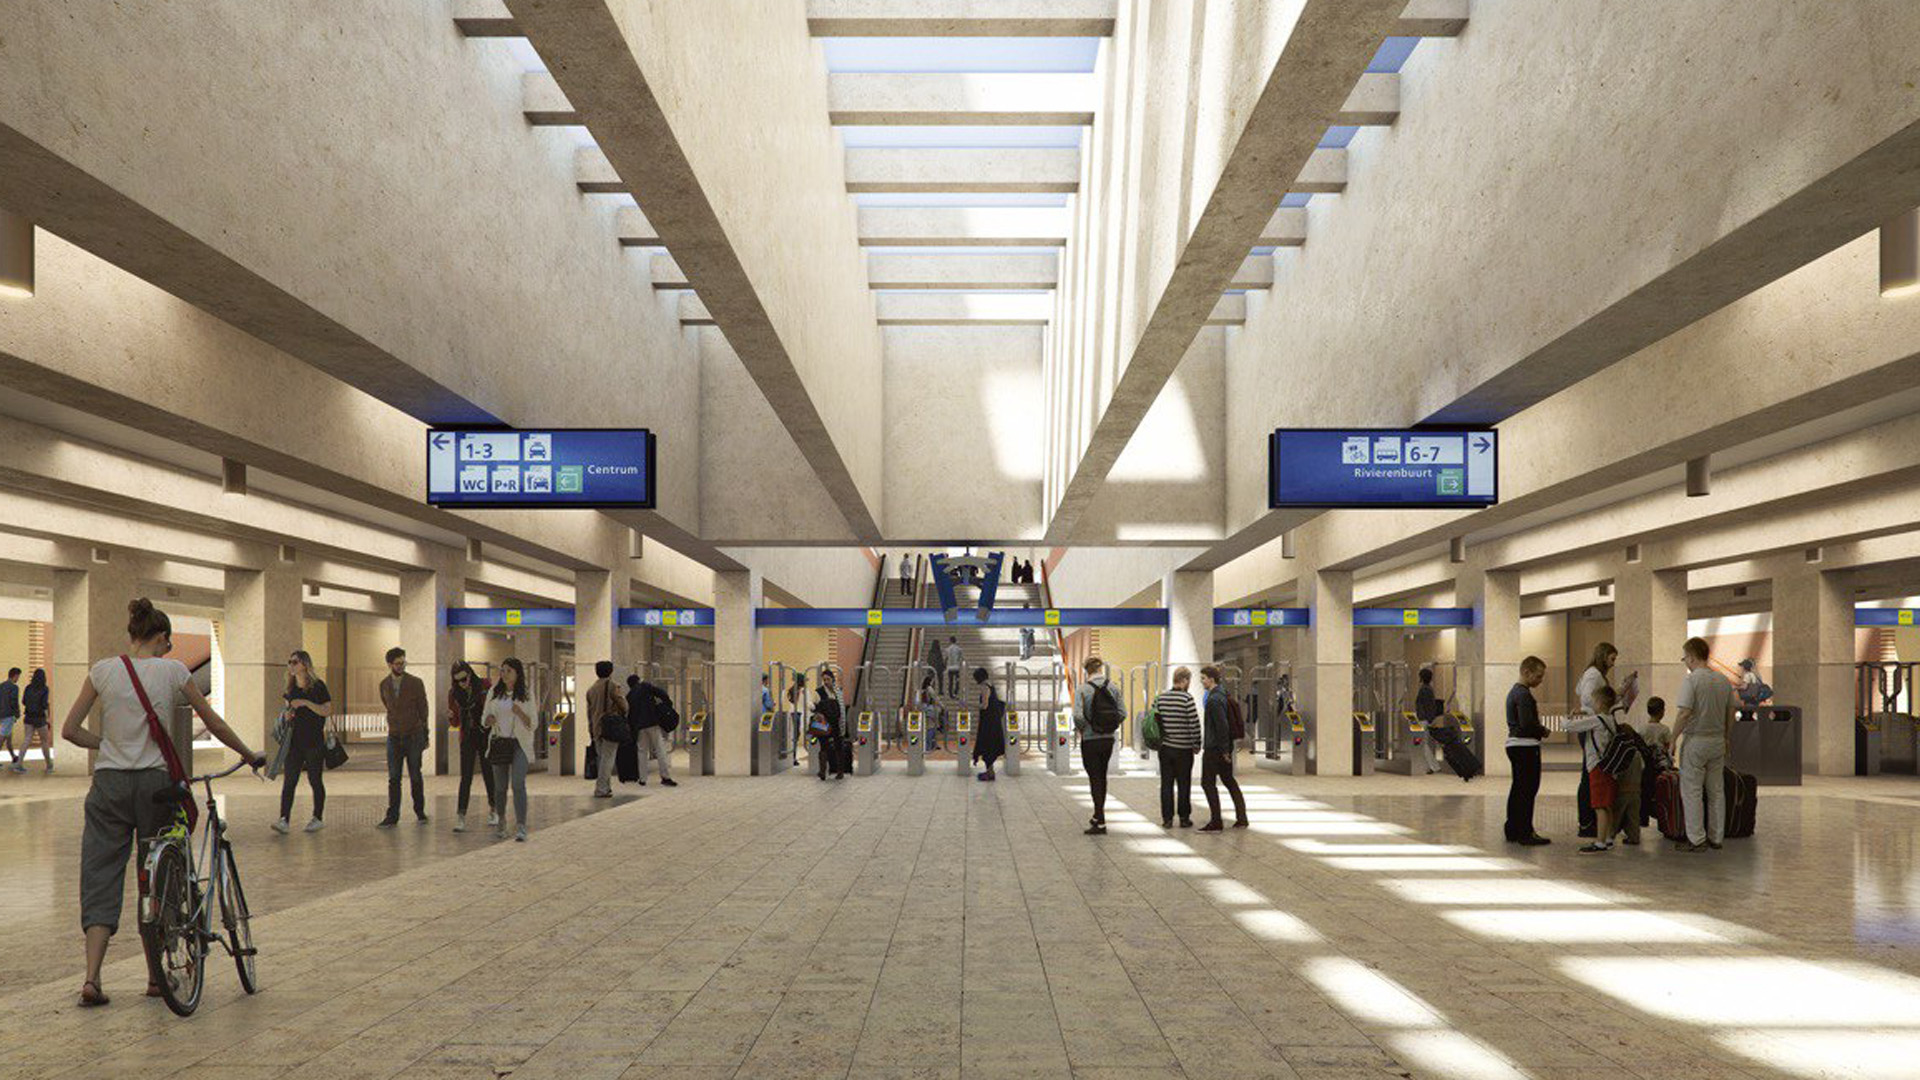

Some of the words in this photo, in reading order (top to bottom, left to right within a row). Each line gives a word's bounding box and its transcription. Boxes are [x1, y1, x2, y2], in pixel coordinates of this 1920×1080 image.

[466, 443, 493, 459] 1-3
[1410, 446, 1440, 462] 6-7
[587, 464, 638, 475] Centrum
[1354, 468, 1432, 478] Rivierenbuurt
[463, 479, 486, 491] WC
[494, 479, 517, 491] P+R
